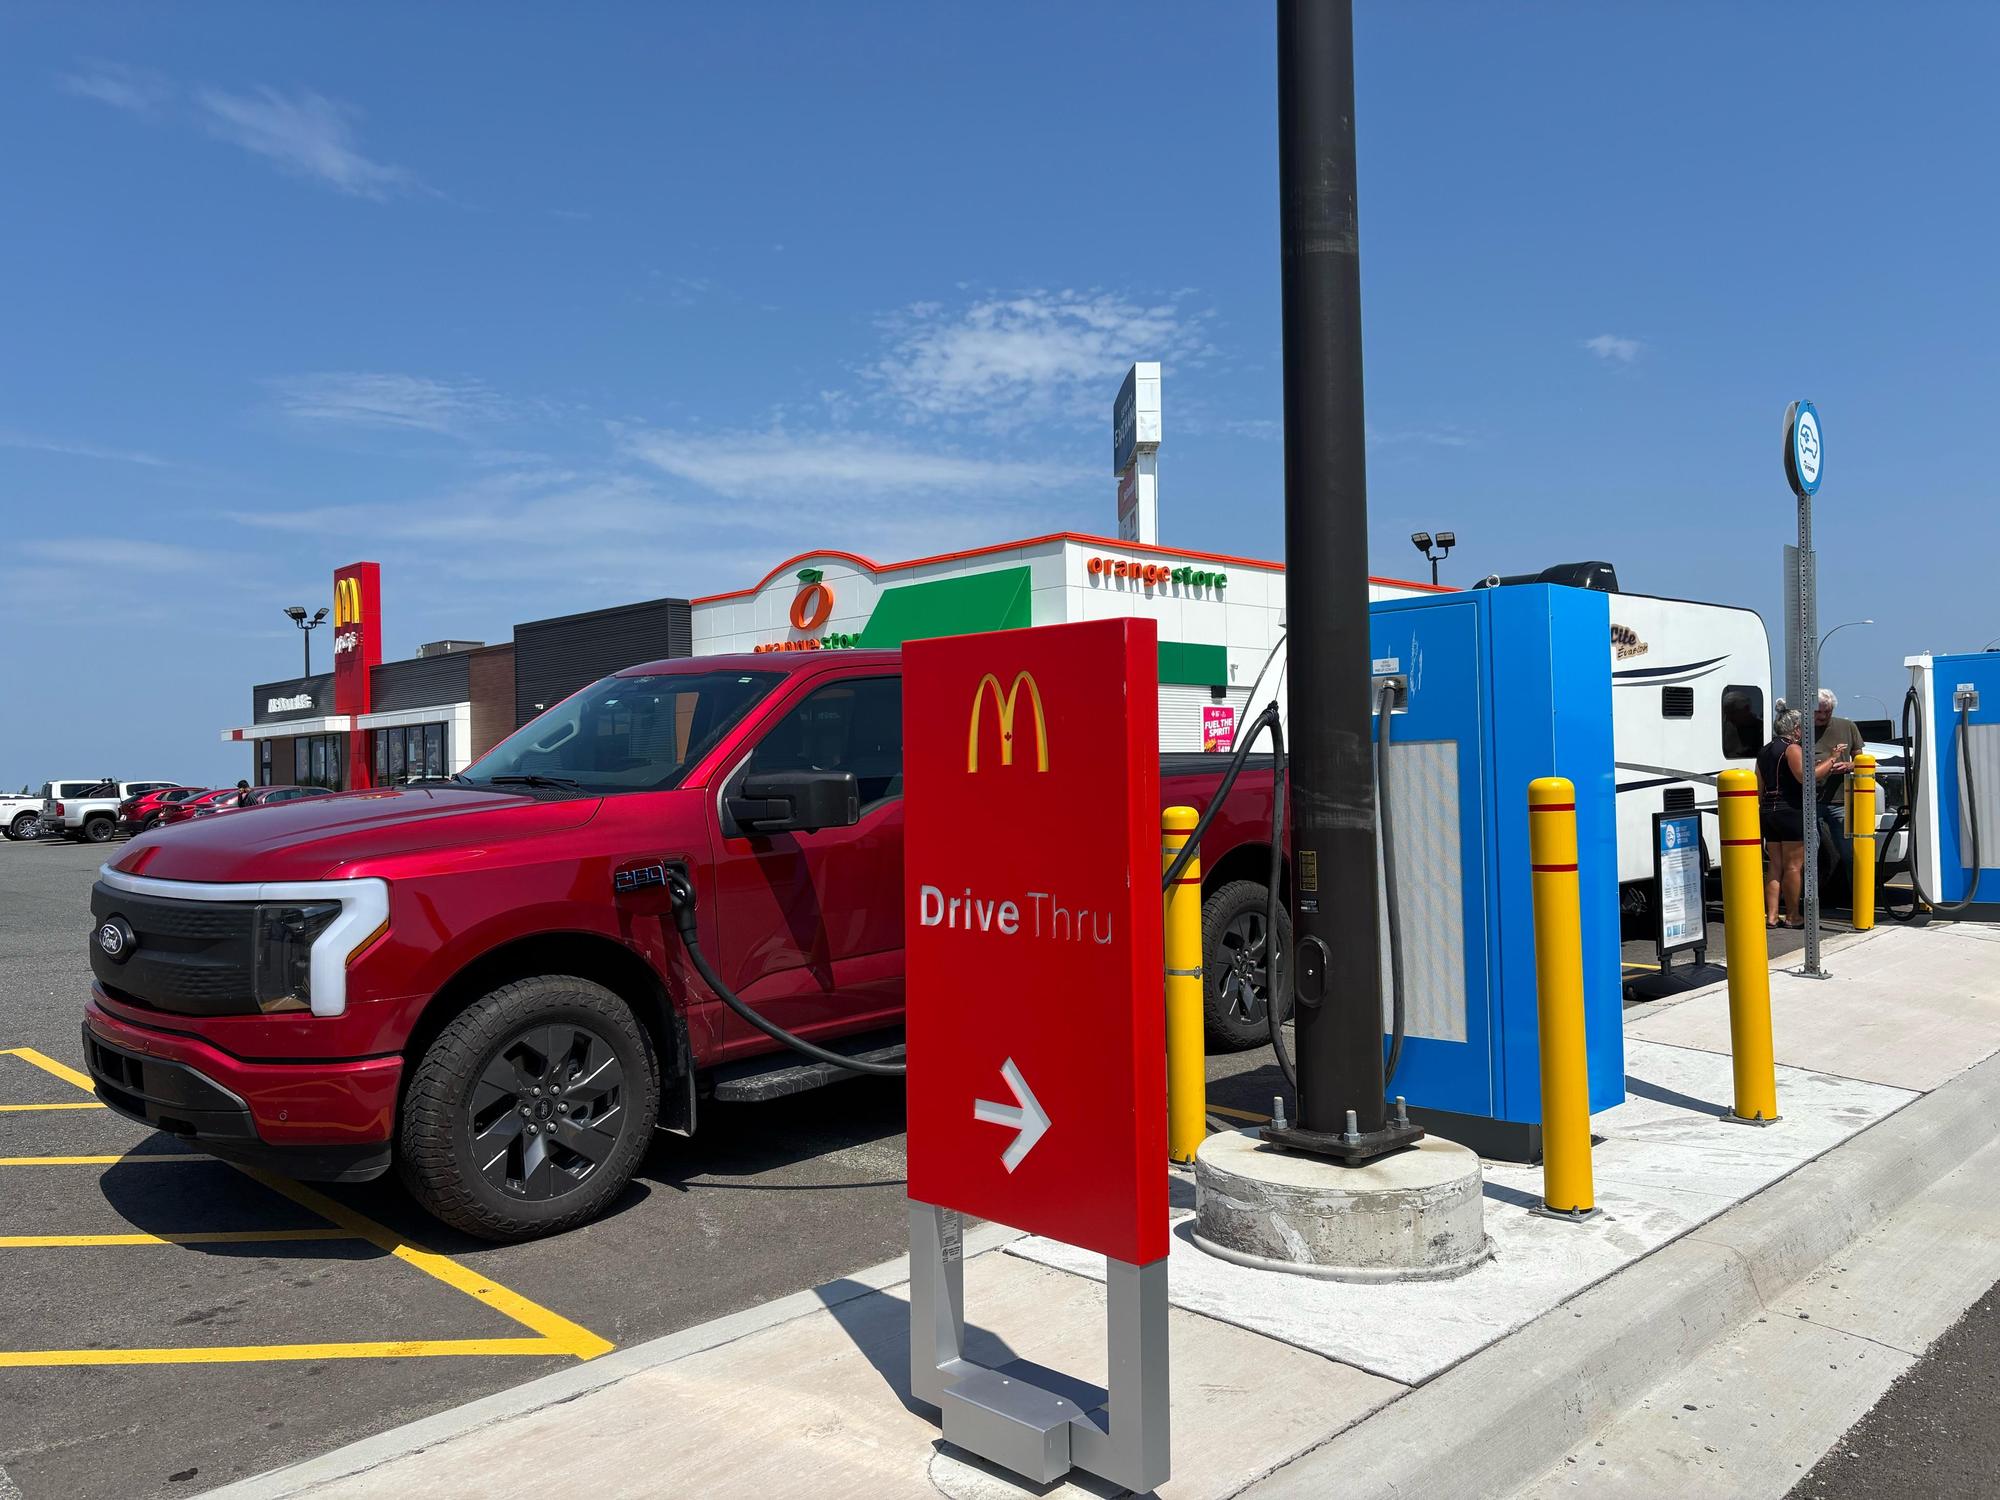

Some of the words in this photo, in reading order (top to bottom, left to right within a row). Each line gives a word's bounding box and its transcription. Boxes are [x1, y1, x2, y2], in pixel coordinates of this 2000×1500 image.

[1205, 720, 1220, 730] FUEL
[1221, 718, 1233, 727] THE
[1209, 727, 1230, 737] SPIRIT!
[920, 884, 1020, 935] Drive
[1025, 891, 1112, 944] Thru
[102, 927, 118, 950] Ford
